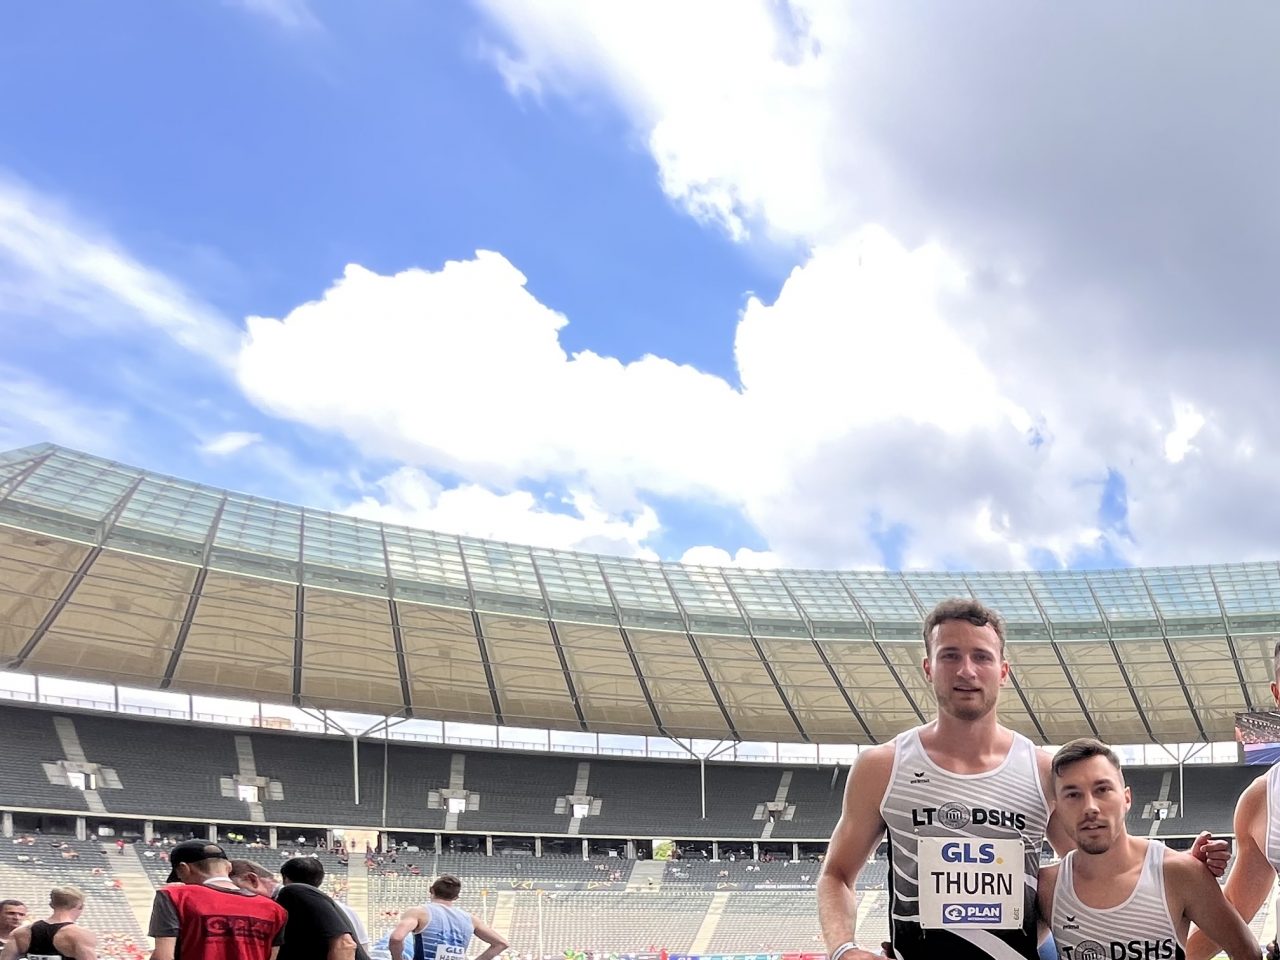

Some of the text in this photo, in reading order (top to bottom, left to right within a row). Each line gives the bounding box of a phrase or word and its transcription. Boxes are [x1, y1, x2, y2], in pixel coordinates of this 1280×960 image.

[912, 808, 936, 826] LT
[972, 808, 1026, 830] DSHS
[931, 871, 1012, 895] THURN
[967, 906, 1000, 917] PLAN
[1110, 939, 1172, 960] DSHS
